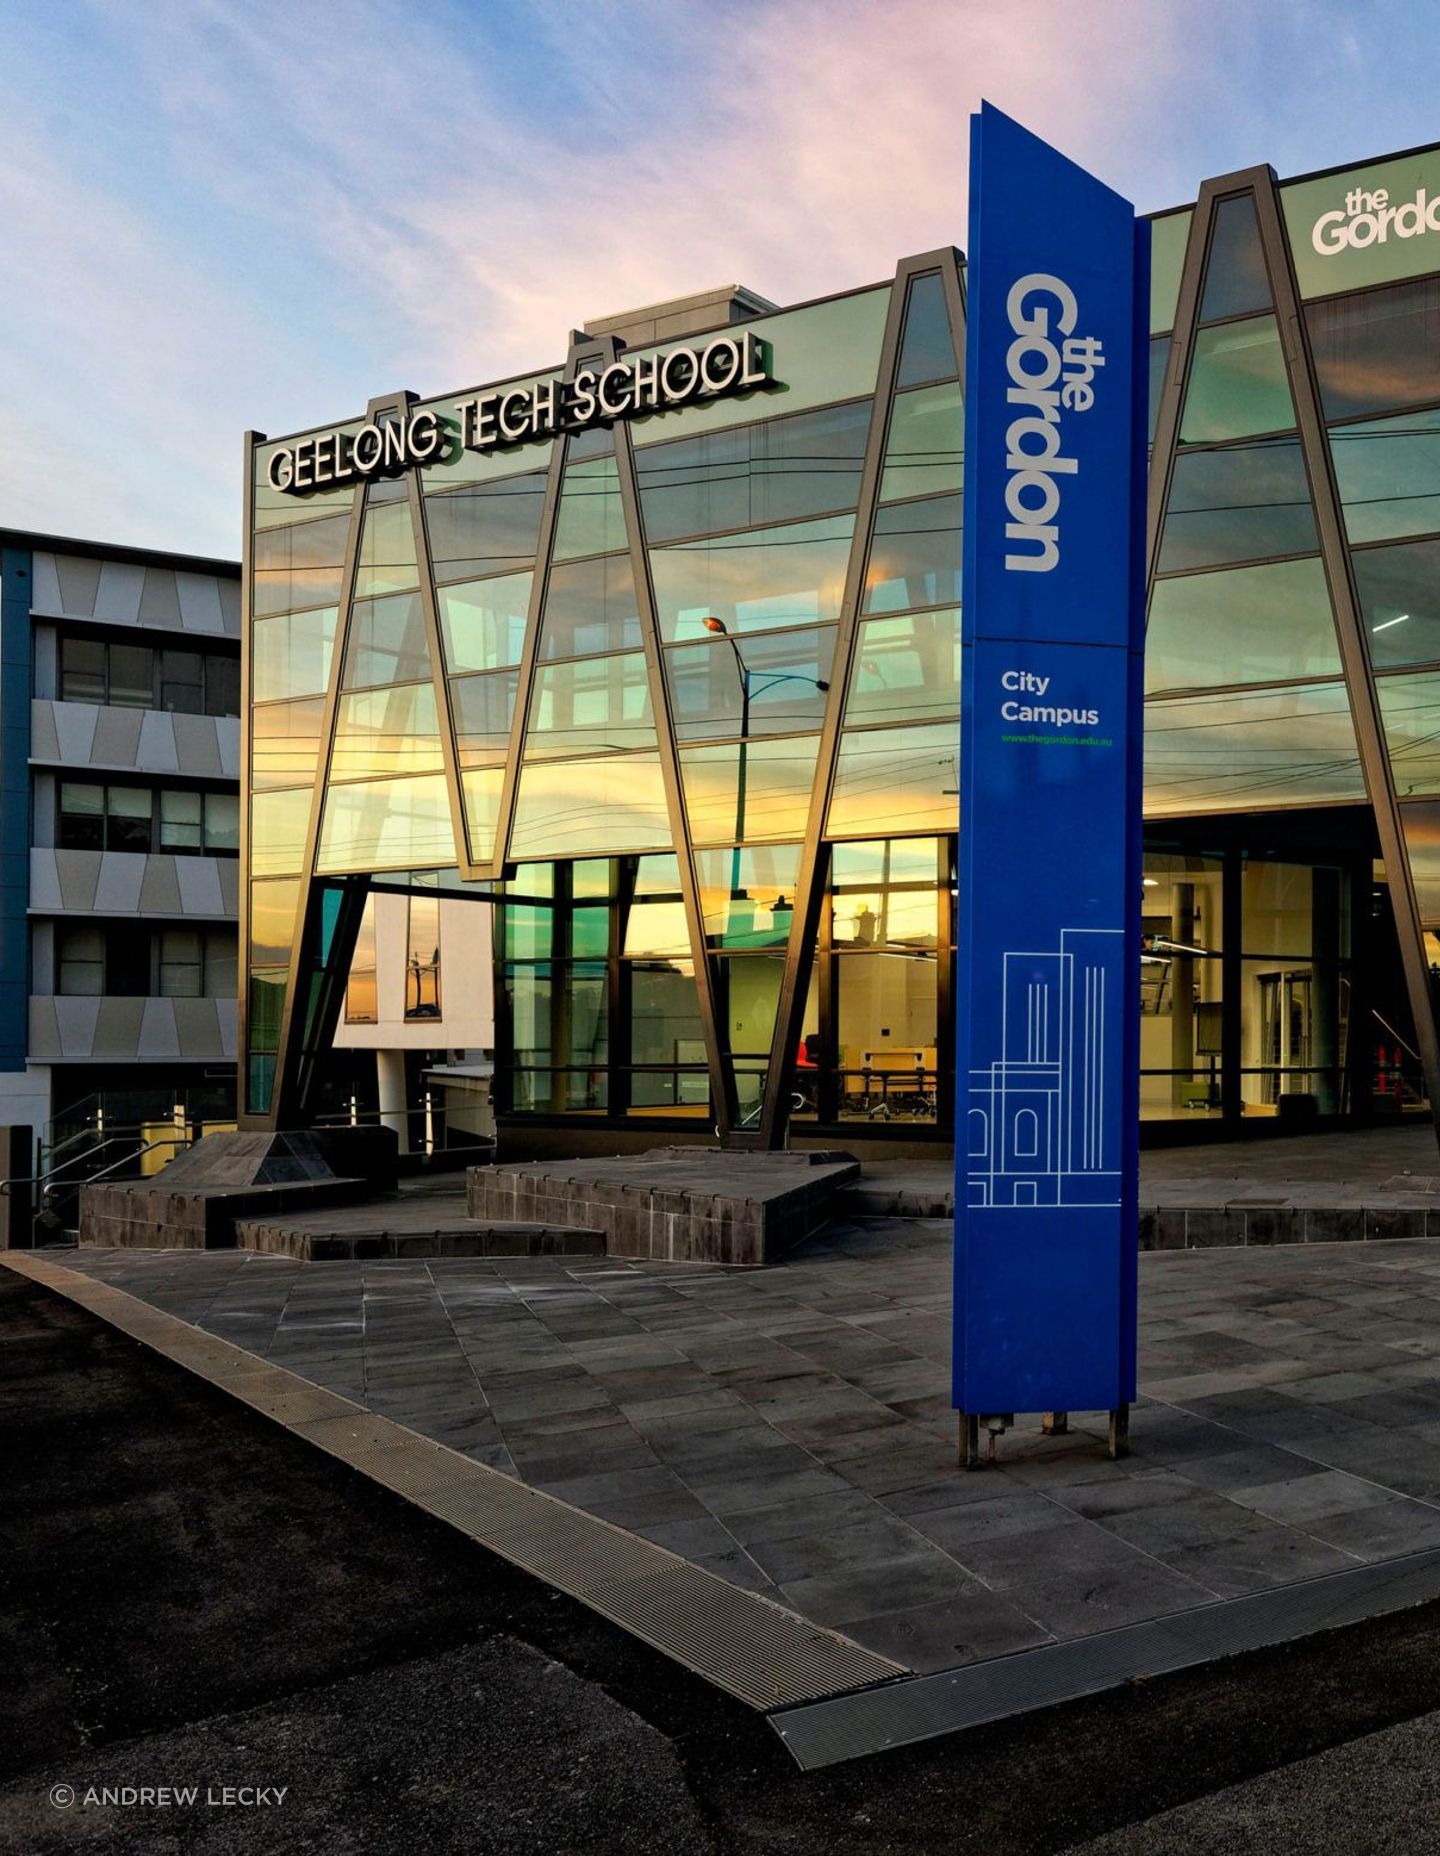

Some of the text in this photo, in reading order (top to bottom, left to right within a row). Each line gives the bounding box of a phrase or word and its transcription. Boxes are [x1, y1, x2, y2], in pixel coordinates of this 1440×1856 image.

[1345, 187, 1389, 216] the
[1061, 336, 1106, 412] the
[267, 331, 766, 492] GEELONG TECH SCHOOL
[1004, 273, 1079, 573] Gordon
[1001, 671, 1050, 696] City
[1001, 701, 1100, 727] Campus
